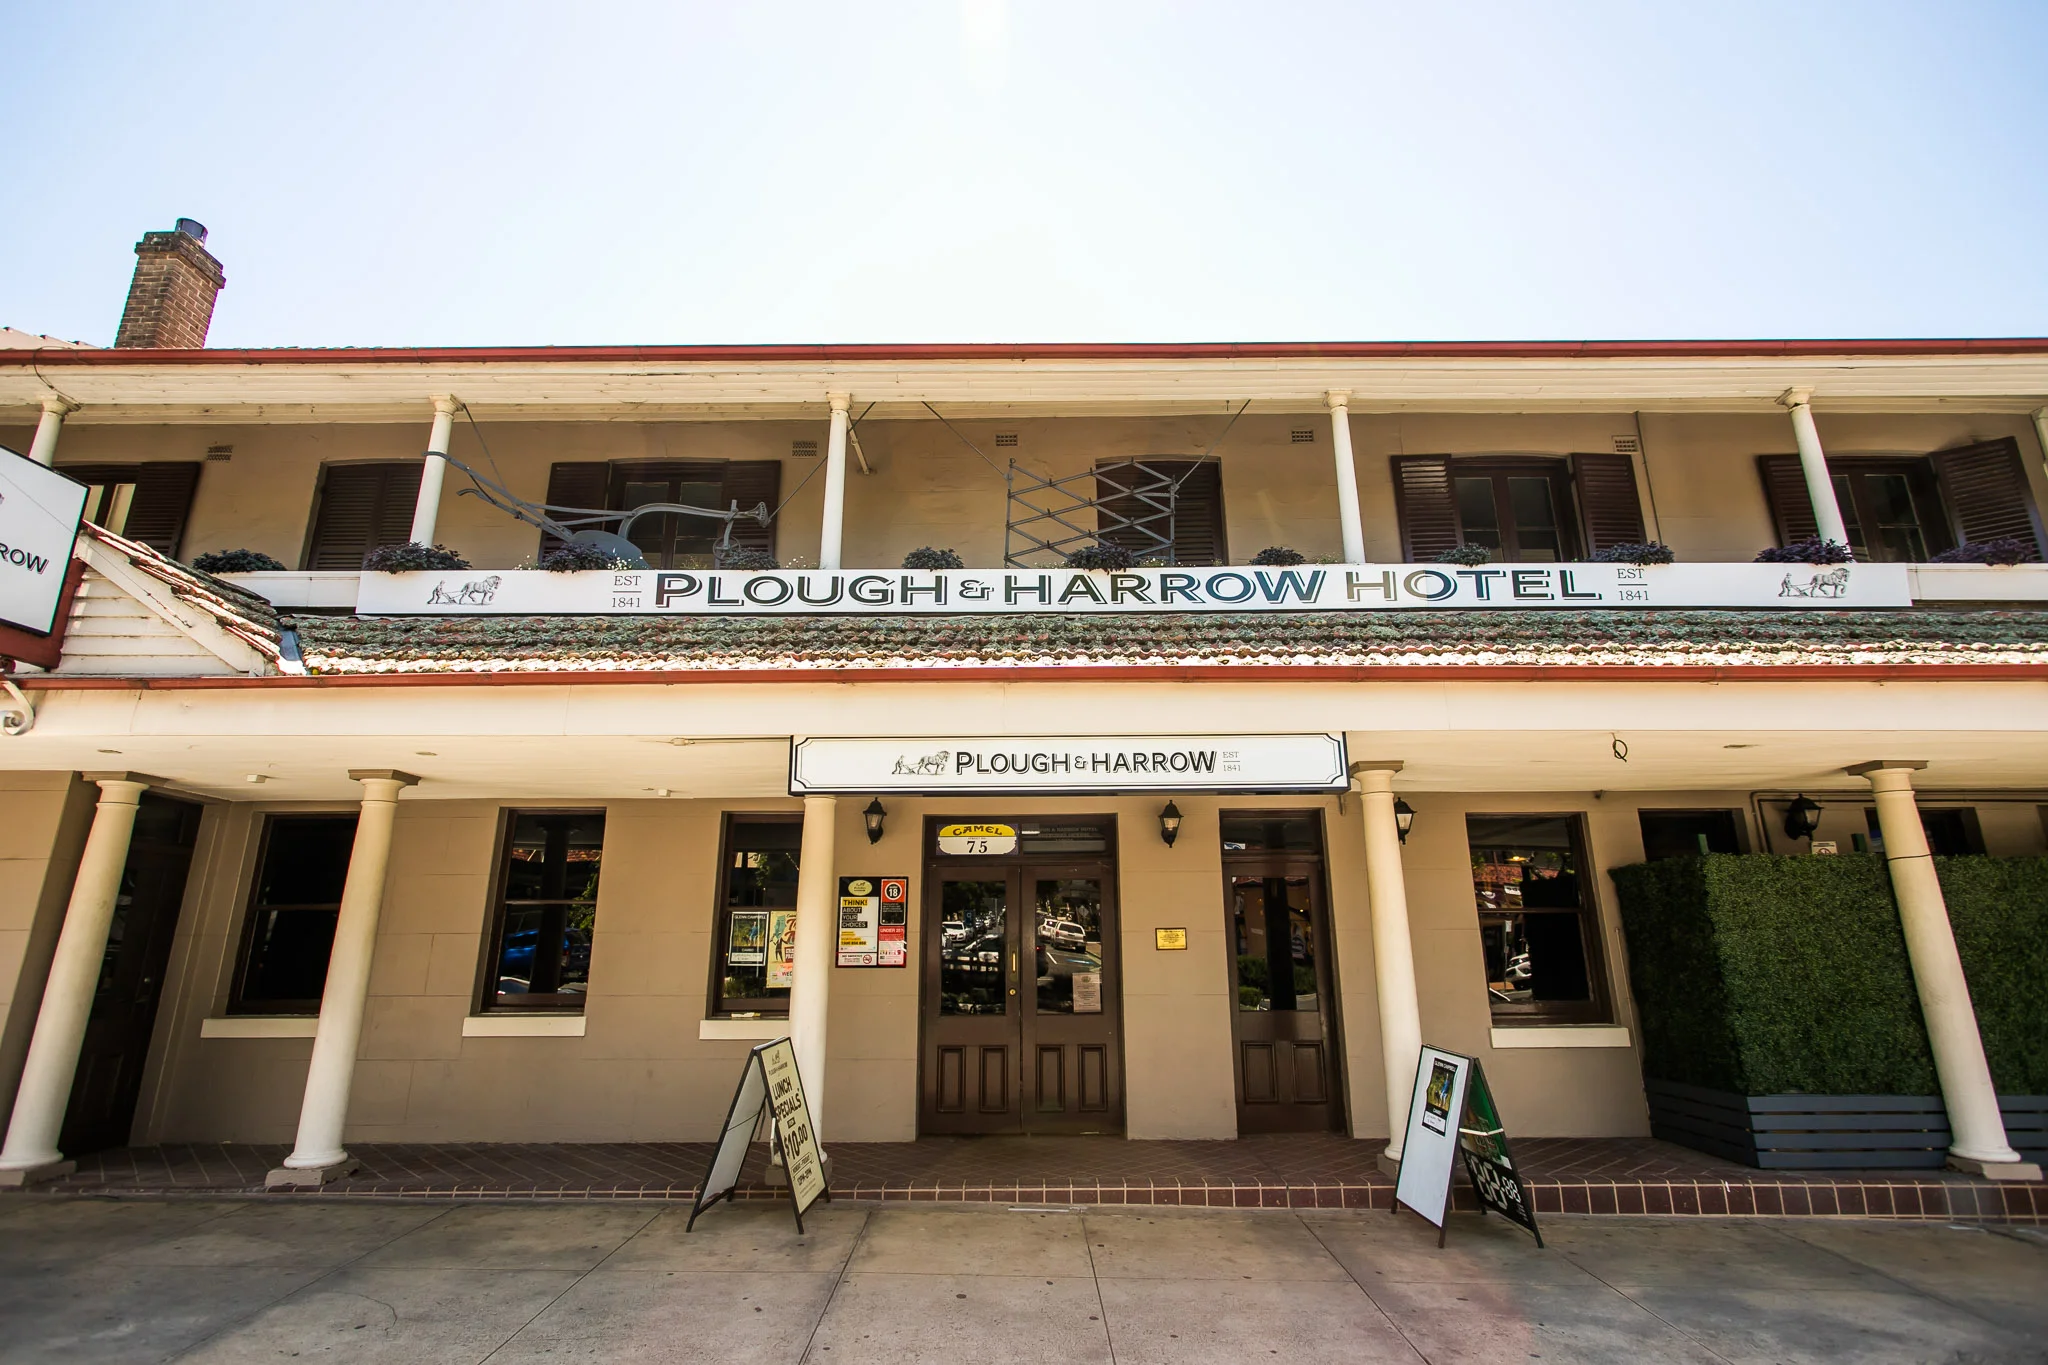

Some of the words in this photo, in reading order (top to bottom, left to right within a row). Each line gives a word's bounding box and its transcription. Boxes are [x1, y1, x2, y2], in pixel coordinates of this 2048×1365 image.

[1616, 568, 1646, 580] EST
[613, 575, 642, 586] EST
[654, 572, 948, 608] PLOUGH
[958, 579, 995, 601] &
[1003, 570, 1328, 606] HARROW
[1345, 569, 1603, 602] HOTEL
[1617, 590, 1650, 602] 1841
[611, 597, 641, 608] 1841
[1222, 751, 1240, 759] EST
[955, 751, 1071, 775] PLOUGH
[1074, 755, 1088, 771] &
[1091, 750, 1217, 774] HARROW
[1222, 764, 1242, 772] 1841
[952, 825, 1003, 836] CAMEL
[966, 840, 988, 854] 75
[888, 889, 898, 897] 18
[771, 1076, 793, 1100] LUNCH
[783, 1123, 808, 1160] $10.00
